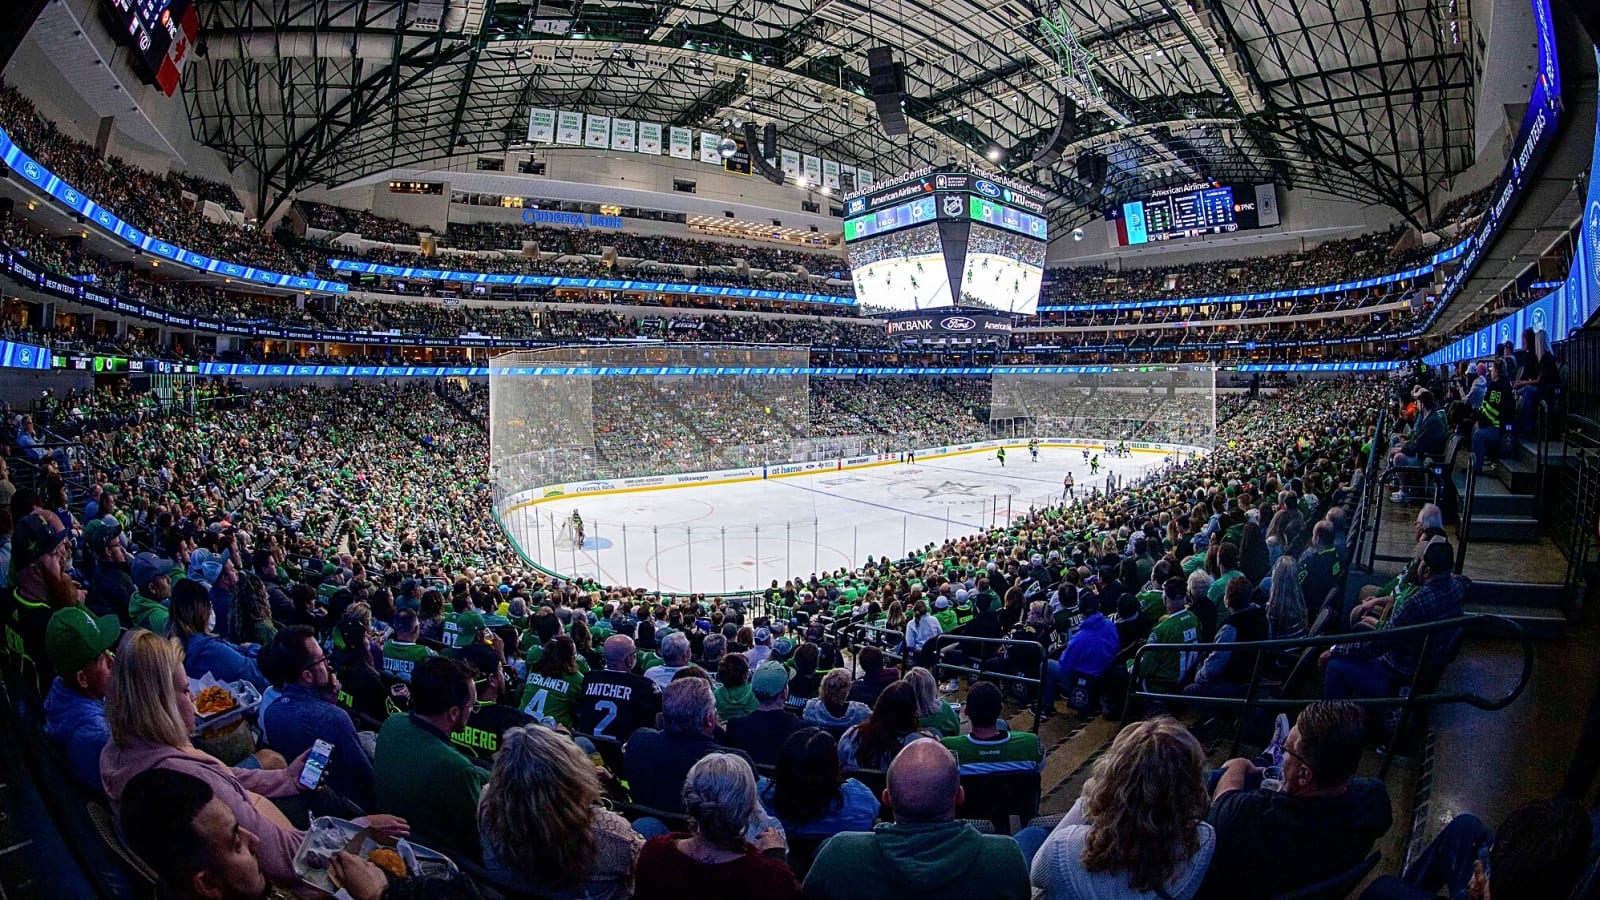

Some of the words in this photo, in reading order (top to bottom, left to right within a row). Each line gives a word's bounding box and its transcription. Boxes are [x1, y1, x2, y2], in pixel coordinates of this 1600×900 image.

[1240, 202, 1255, 211] PNC
[589, 213, 624, 230] Bank
[771, 467, 780, 475] at
[780, 465, 803, 474] home
[678, 475, 709, 483] Volkswagen
[527, 673, 570, 694] EISKANEN
[585, 683, 632, 700] HATCHER
[524, 688, 549, 721] 4
[593, 700, 618, 740] 2
